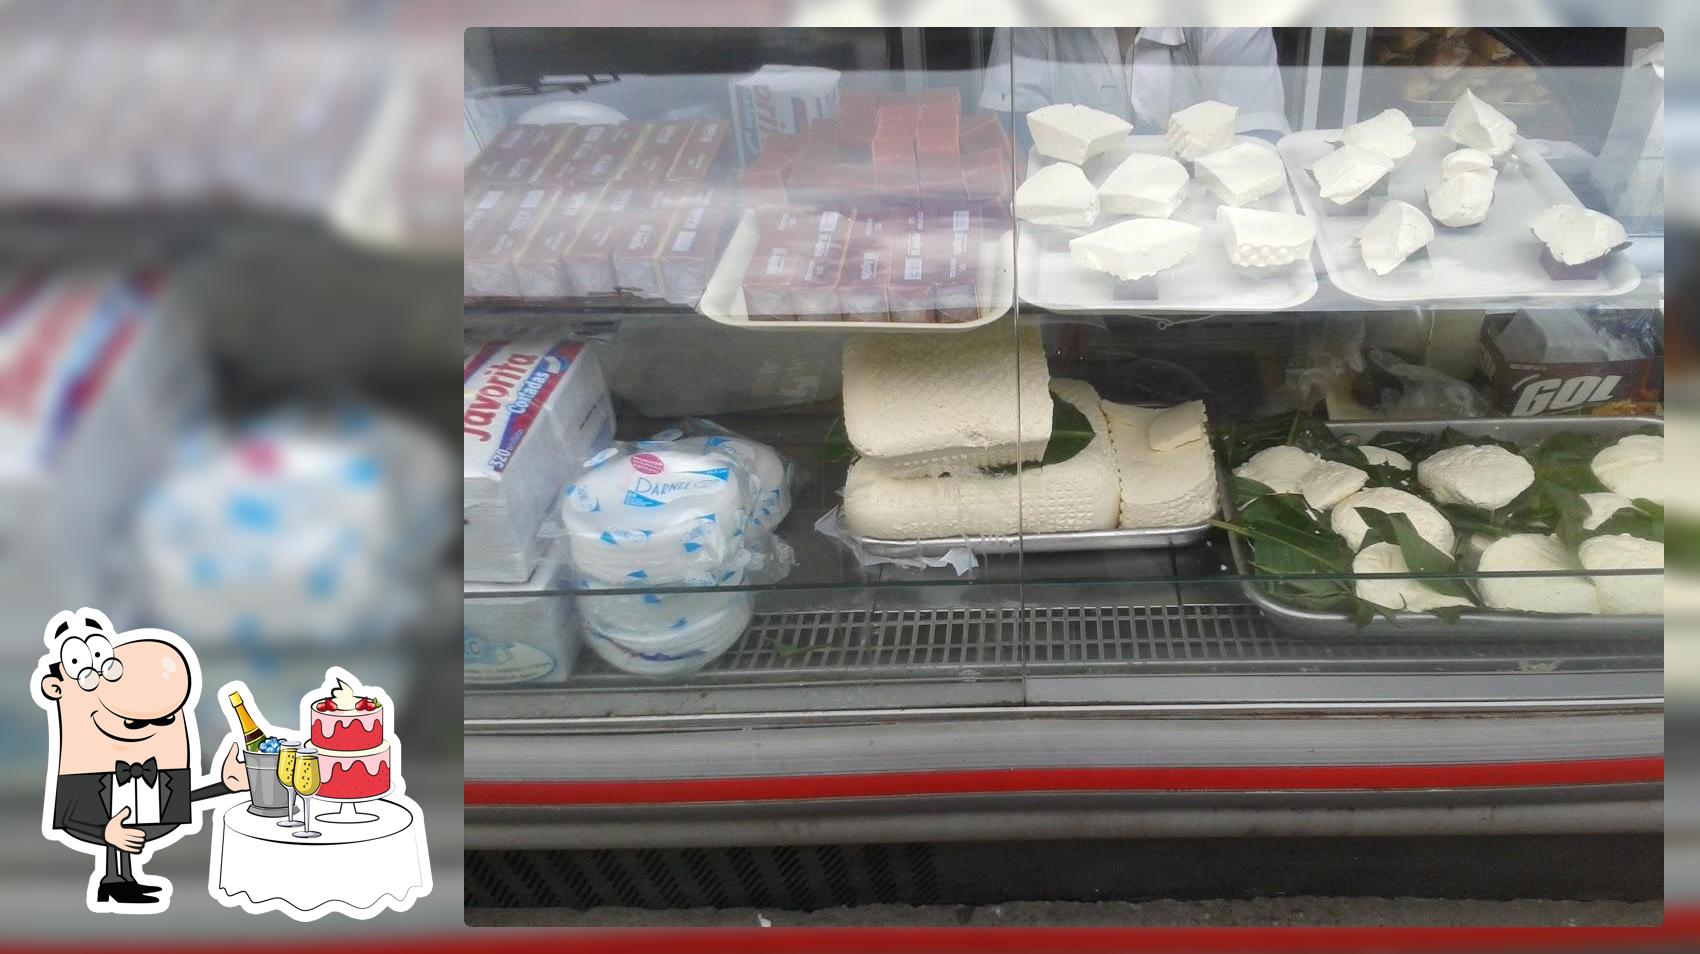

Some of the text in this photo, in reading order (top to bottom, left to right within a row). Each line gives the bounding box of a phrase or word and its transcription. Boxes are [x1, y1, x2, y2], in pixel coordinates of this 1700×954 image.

[507, 371, 550, 414] Cortadas
[1511, 375, 1624, 417] GOL
[488, 448, 511, 469] 320
